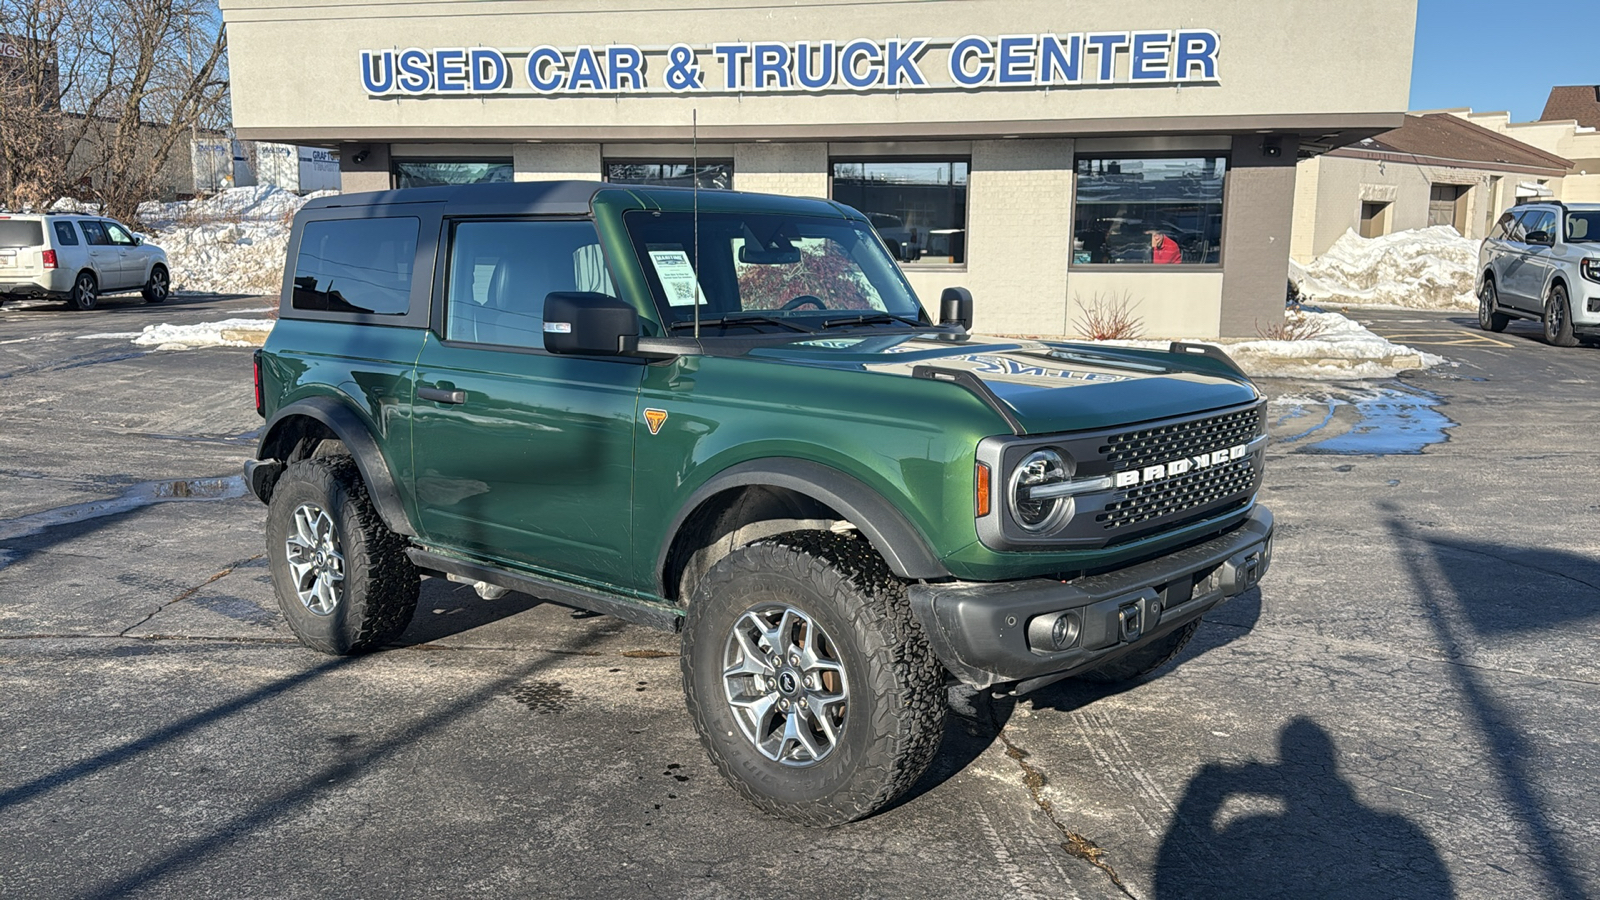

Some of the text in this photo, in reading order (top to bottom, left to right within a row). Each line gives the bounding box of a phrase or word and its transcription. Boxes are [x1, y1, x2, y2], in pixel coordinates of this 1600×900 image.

[359, 28, 1221, 96] USED CAR & TRUCK CENTER
[1116, 444, 1246, 487] BRONCO
